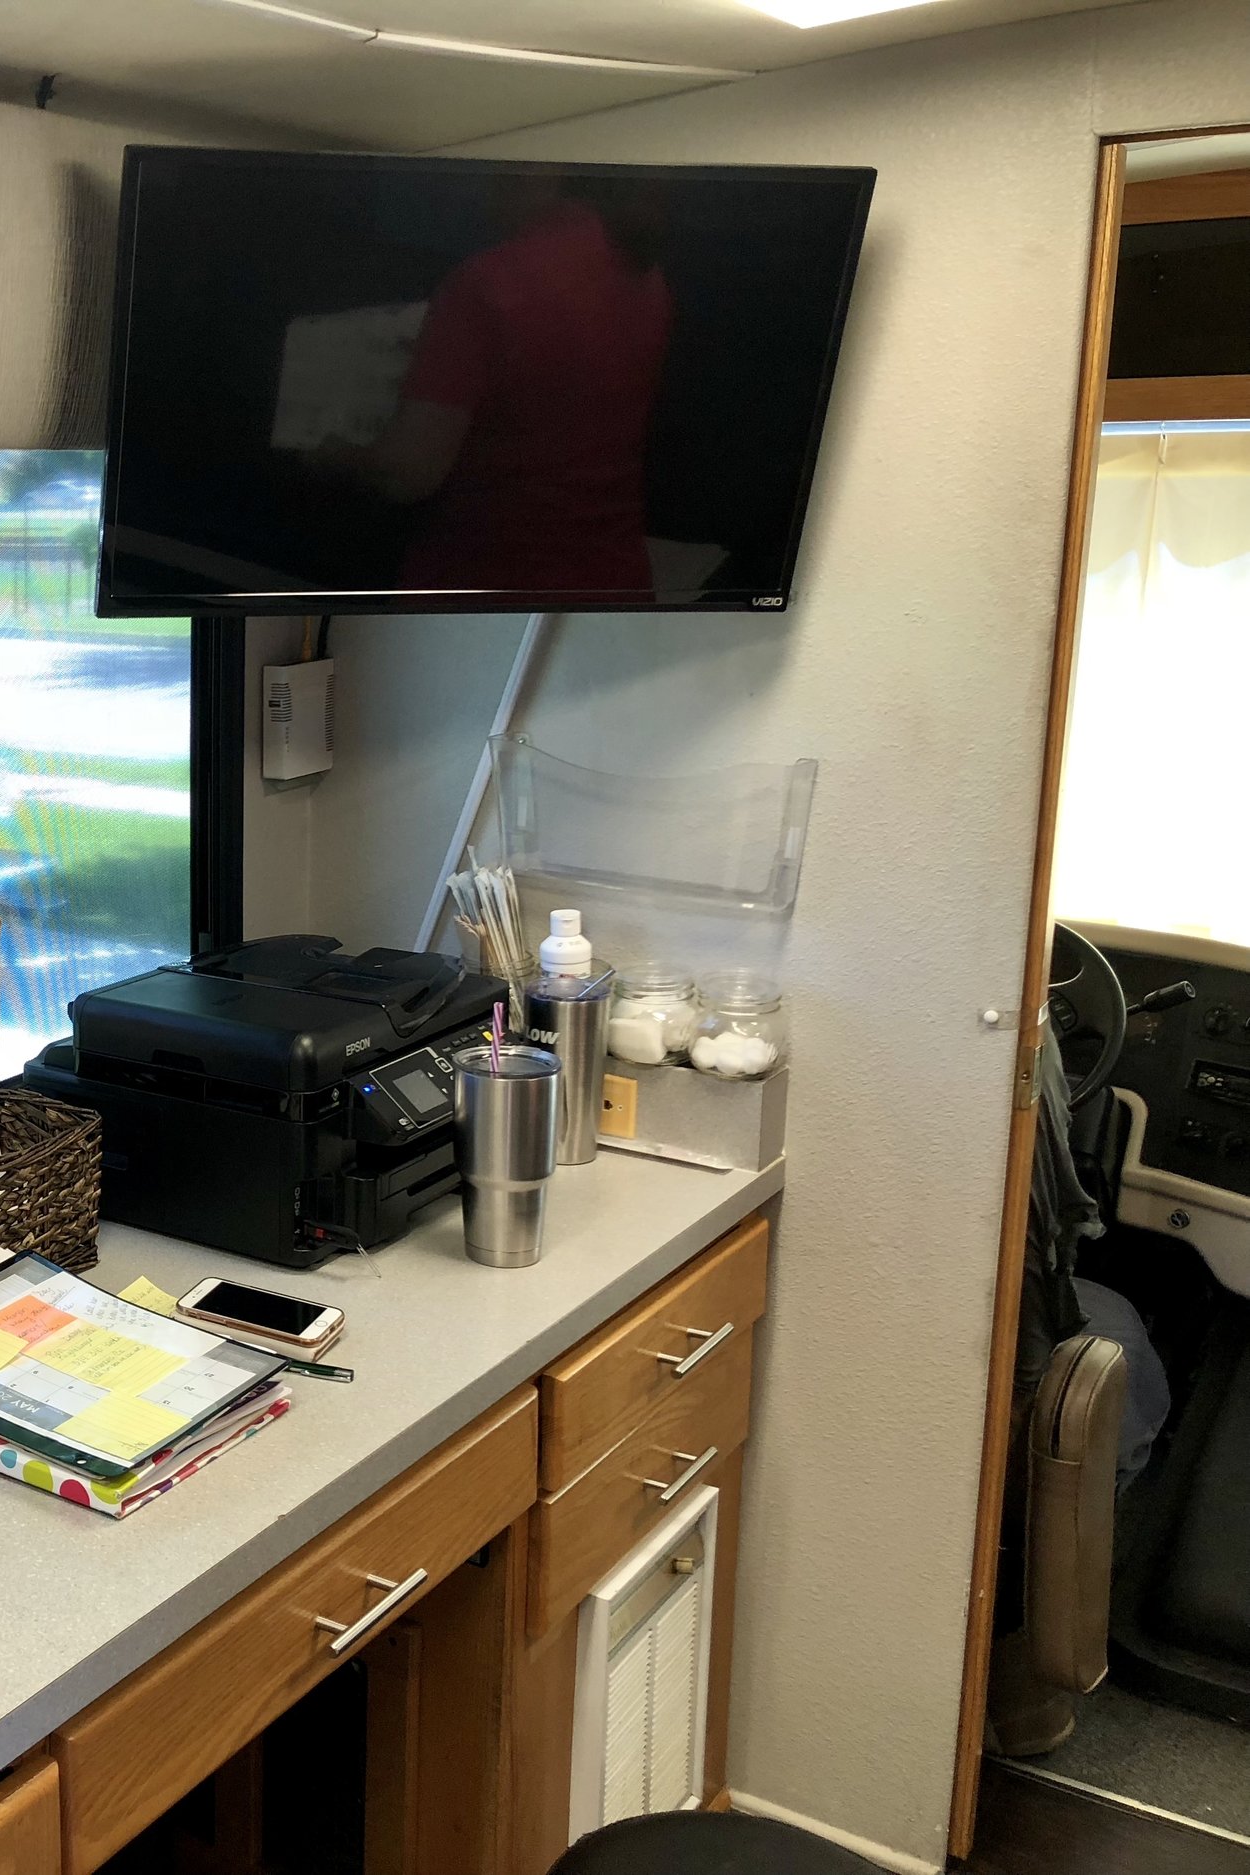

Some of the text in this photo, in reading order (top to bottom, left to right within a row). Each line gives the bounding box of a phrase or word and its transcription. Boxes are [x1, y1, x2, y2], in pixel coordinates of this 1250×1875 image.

[752, 597, 783, 606] VIZIO
[345, 1036, 370, 1057] EPSON
[10, 1399, 40, 1414] MAY
